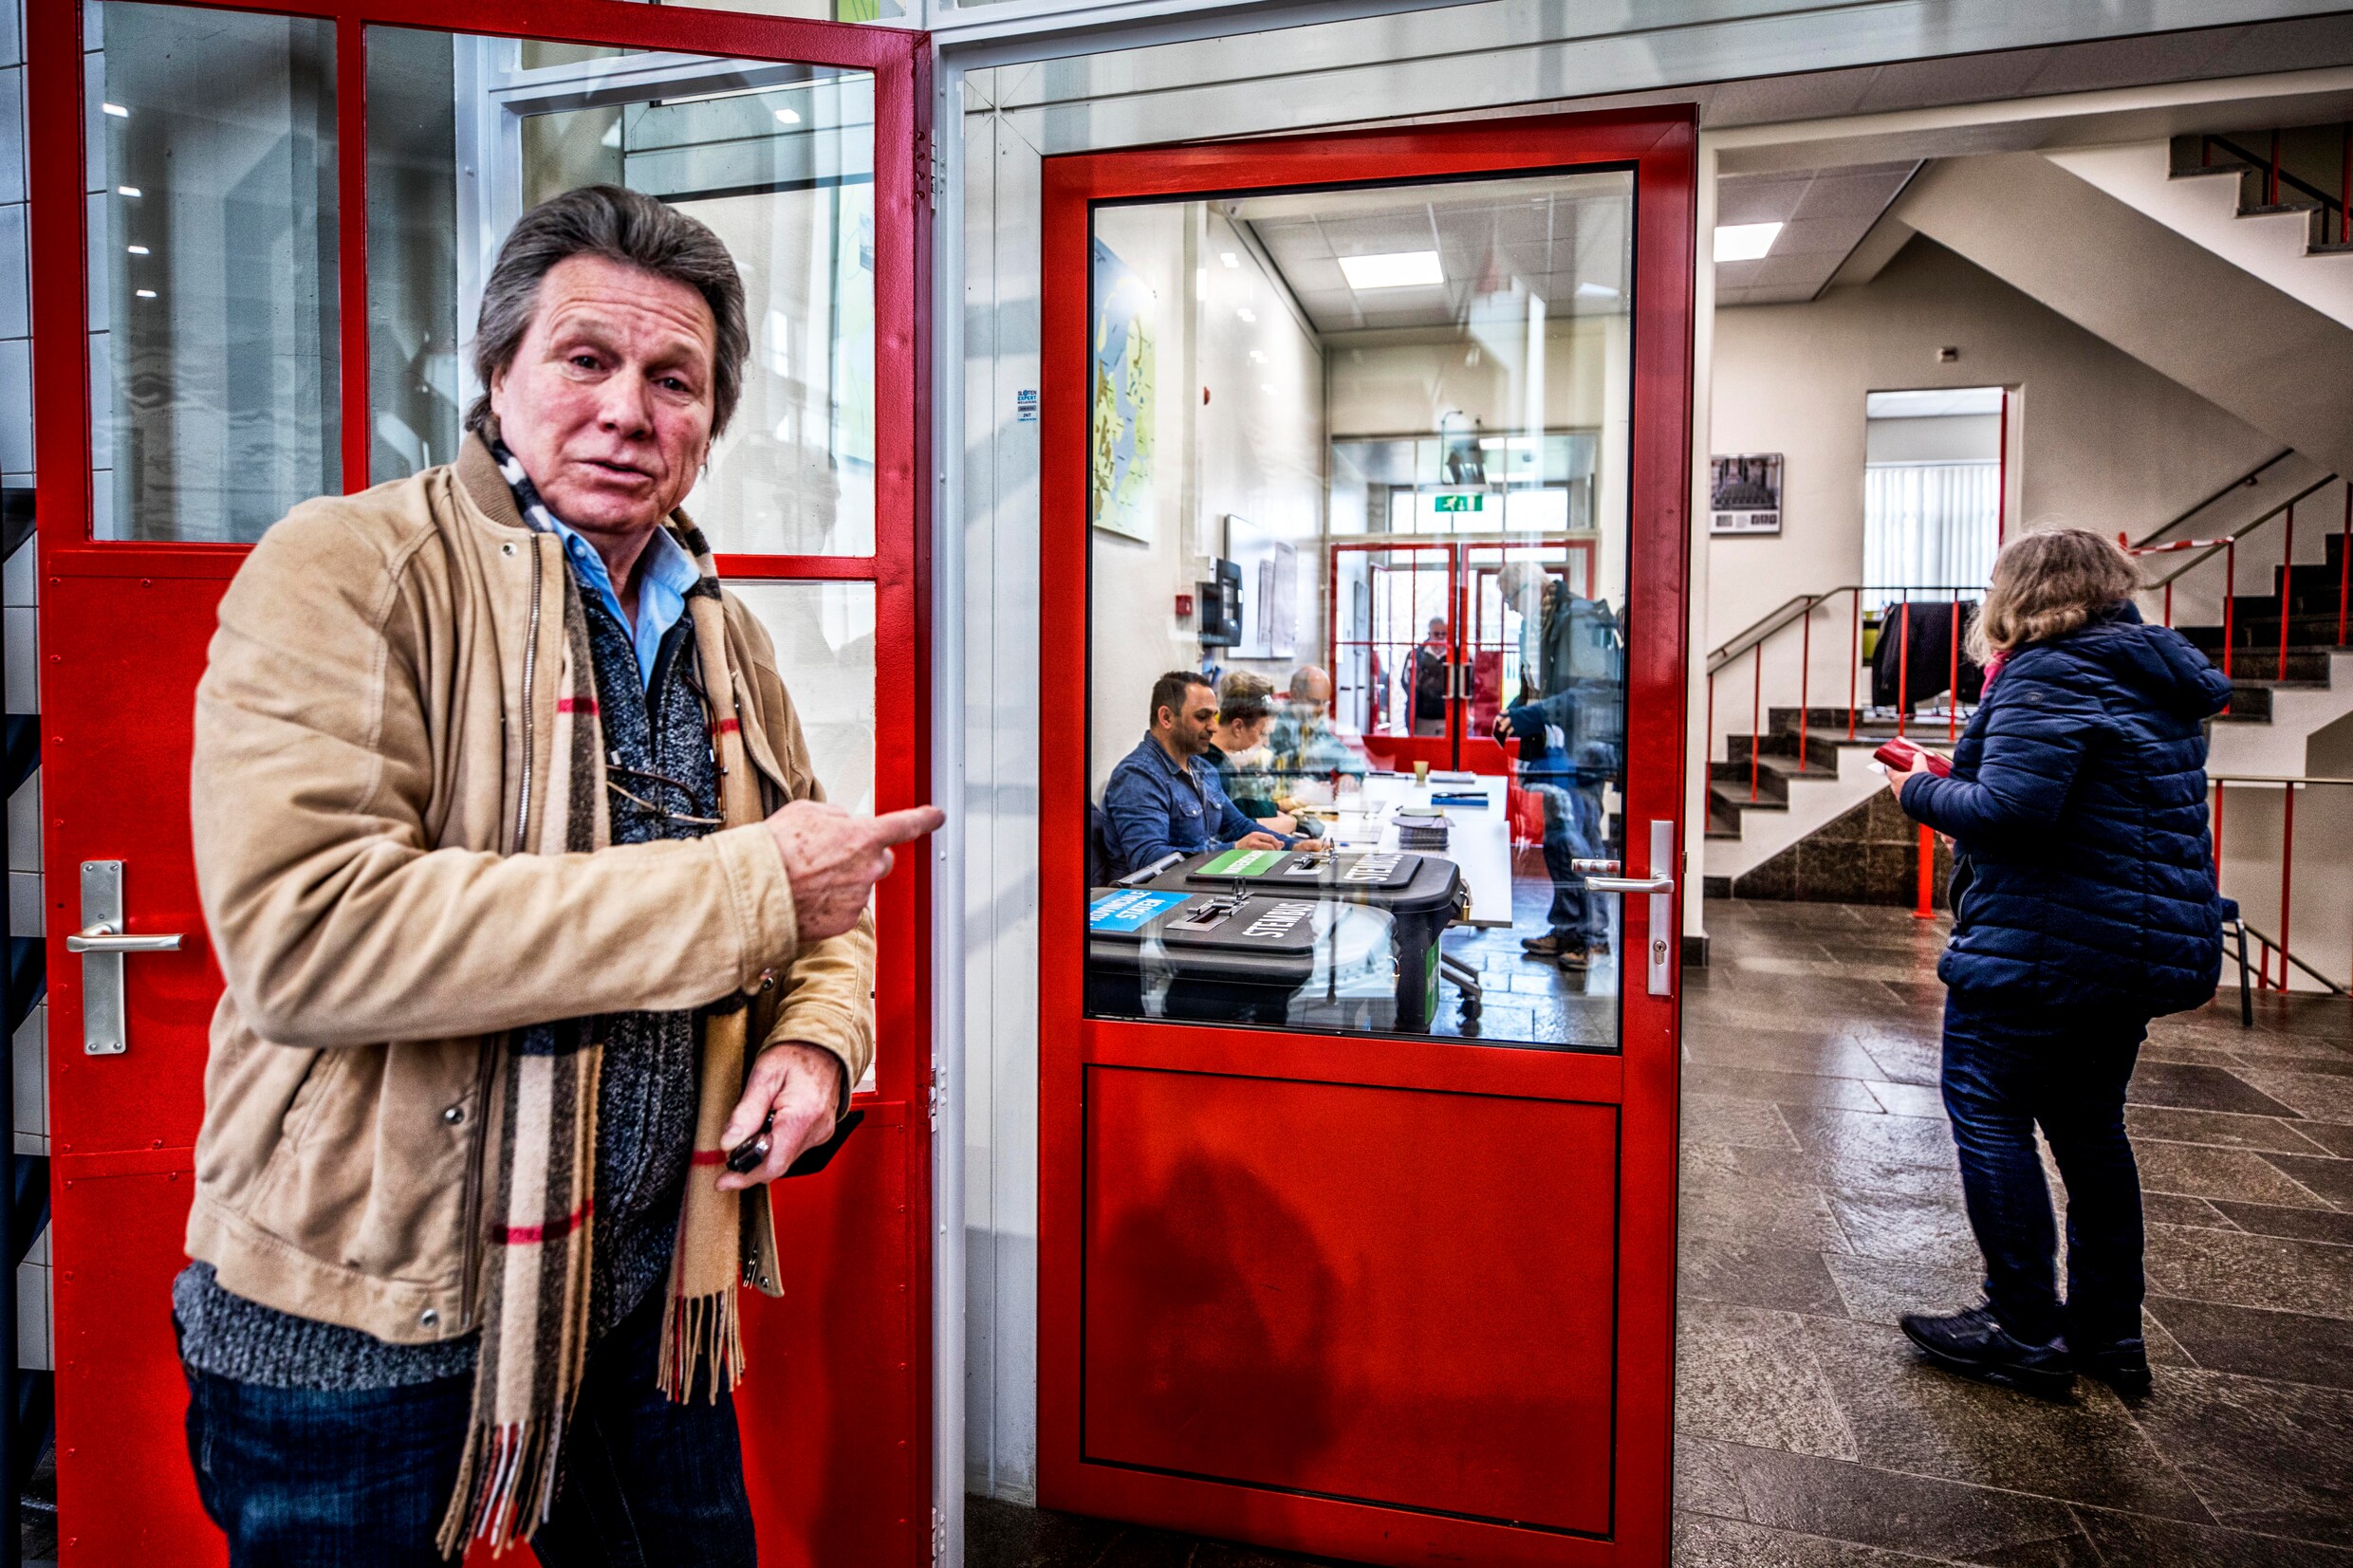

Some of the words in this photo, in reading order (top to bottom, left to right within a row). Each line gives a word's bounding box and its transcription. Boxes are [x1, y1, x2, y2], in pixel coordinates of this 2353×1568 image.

[1090, 892, 1152, 926] ROVINCIALE
[1116, 898, 1166, 920] STATEN
[1242, 903, 1316, 938] STEMBUS
